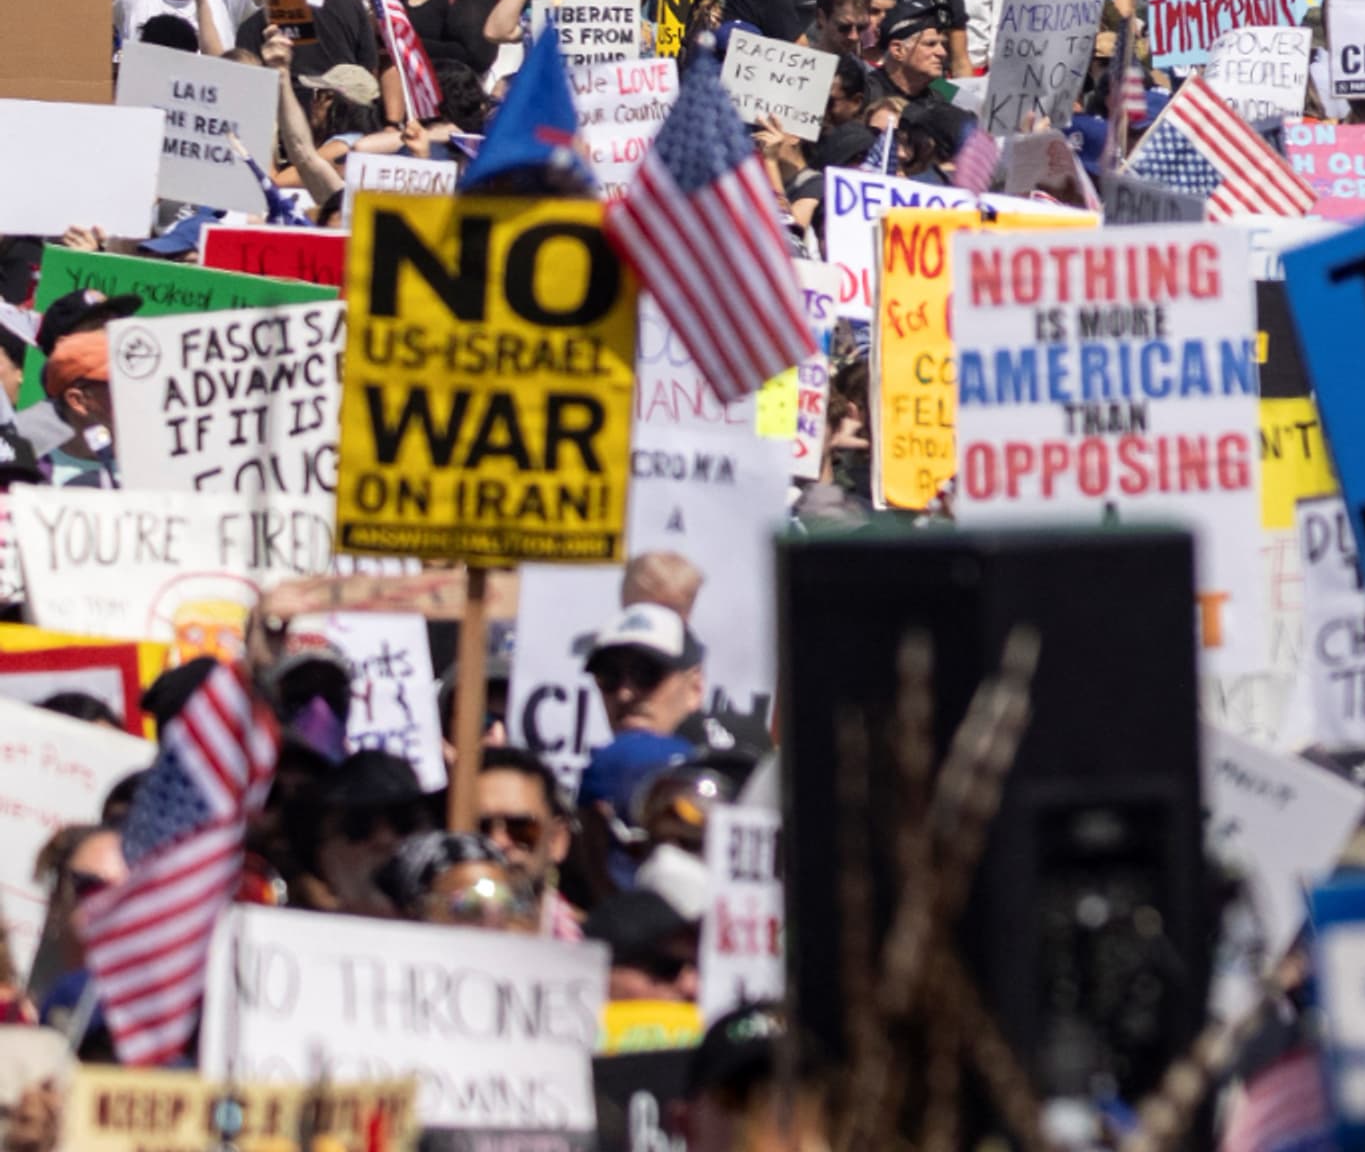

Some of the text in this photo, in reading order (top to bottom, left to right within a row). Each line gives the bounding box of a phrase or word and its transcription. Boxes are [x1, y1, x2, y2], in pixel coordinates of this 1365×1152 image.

[616, 61, 670, 95] LOVE
[735, 38, 816, 70] RACISM
[735, 63, 809, 91] IS NOT
[368, 209, 622, 328] NO
[968, 242, 1221, 307] NOTHING
[1034, 304, 1170, 342] IS MORE
[362, 328, 614, 377] US-ISRAEL
[958, 338, 1256, 407] AMERICAN
[170, 406, 266, 457] IF IT
[360, 384, 609, 473] WAR
[1061, 400, 1150, 437] THAN
[962, 433, 1251, 502] OPPOSING
[355, 475, 611, 523] ON IRAN!
[33, 502, 194, 571] YOU'RE
